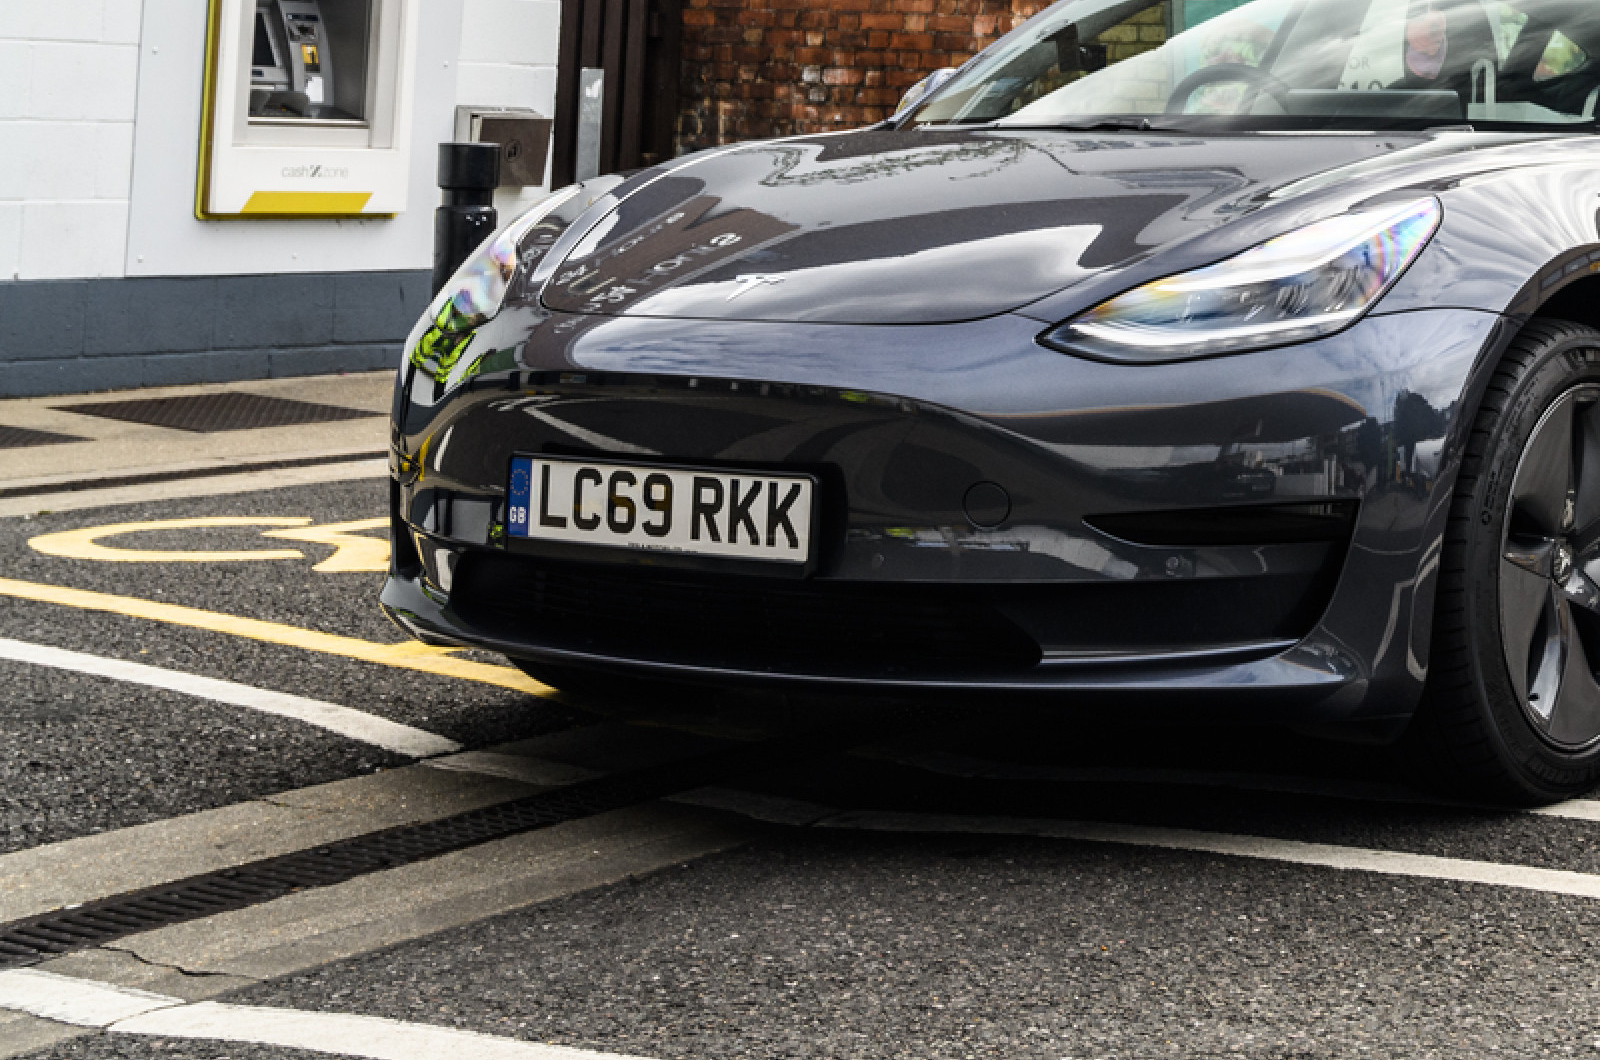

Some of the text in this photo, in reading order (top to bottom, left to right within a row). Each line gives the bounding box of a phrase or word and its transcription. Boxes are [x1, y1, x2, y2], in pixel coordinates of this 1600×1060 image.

[509, 505, 527, 523] GB
[540, 464, 802, 549] LC69 RKK
